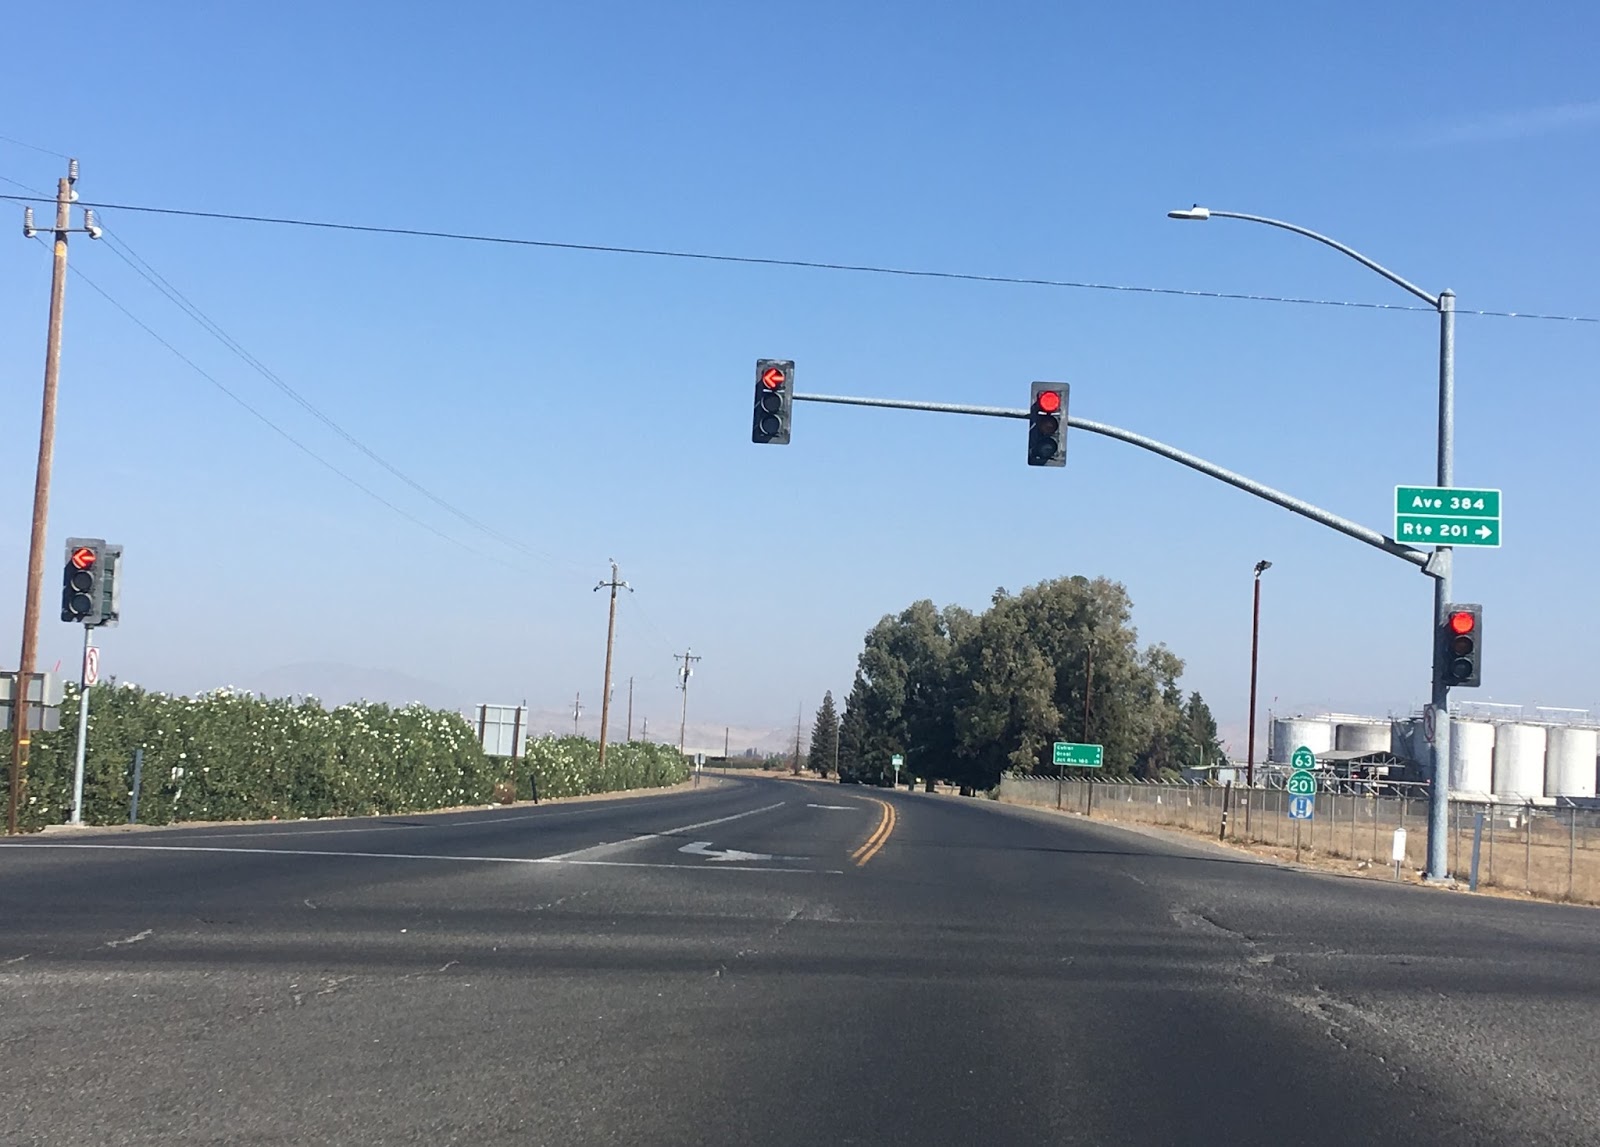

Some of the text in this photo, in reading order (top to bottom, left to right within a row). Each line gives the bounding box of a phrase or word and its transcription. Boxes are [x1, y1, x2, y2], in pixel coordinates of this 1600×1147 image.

[1412, 496, 1484, 510] Ave 384
[1403, 523, 1468, 537] Rte 201
[1295, 755, 1312, 767] 63
[1290, 780, 1314, 792] 201
